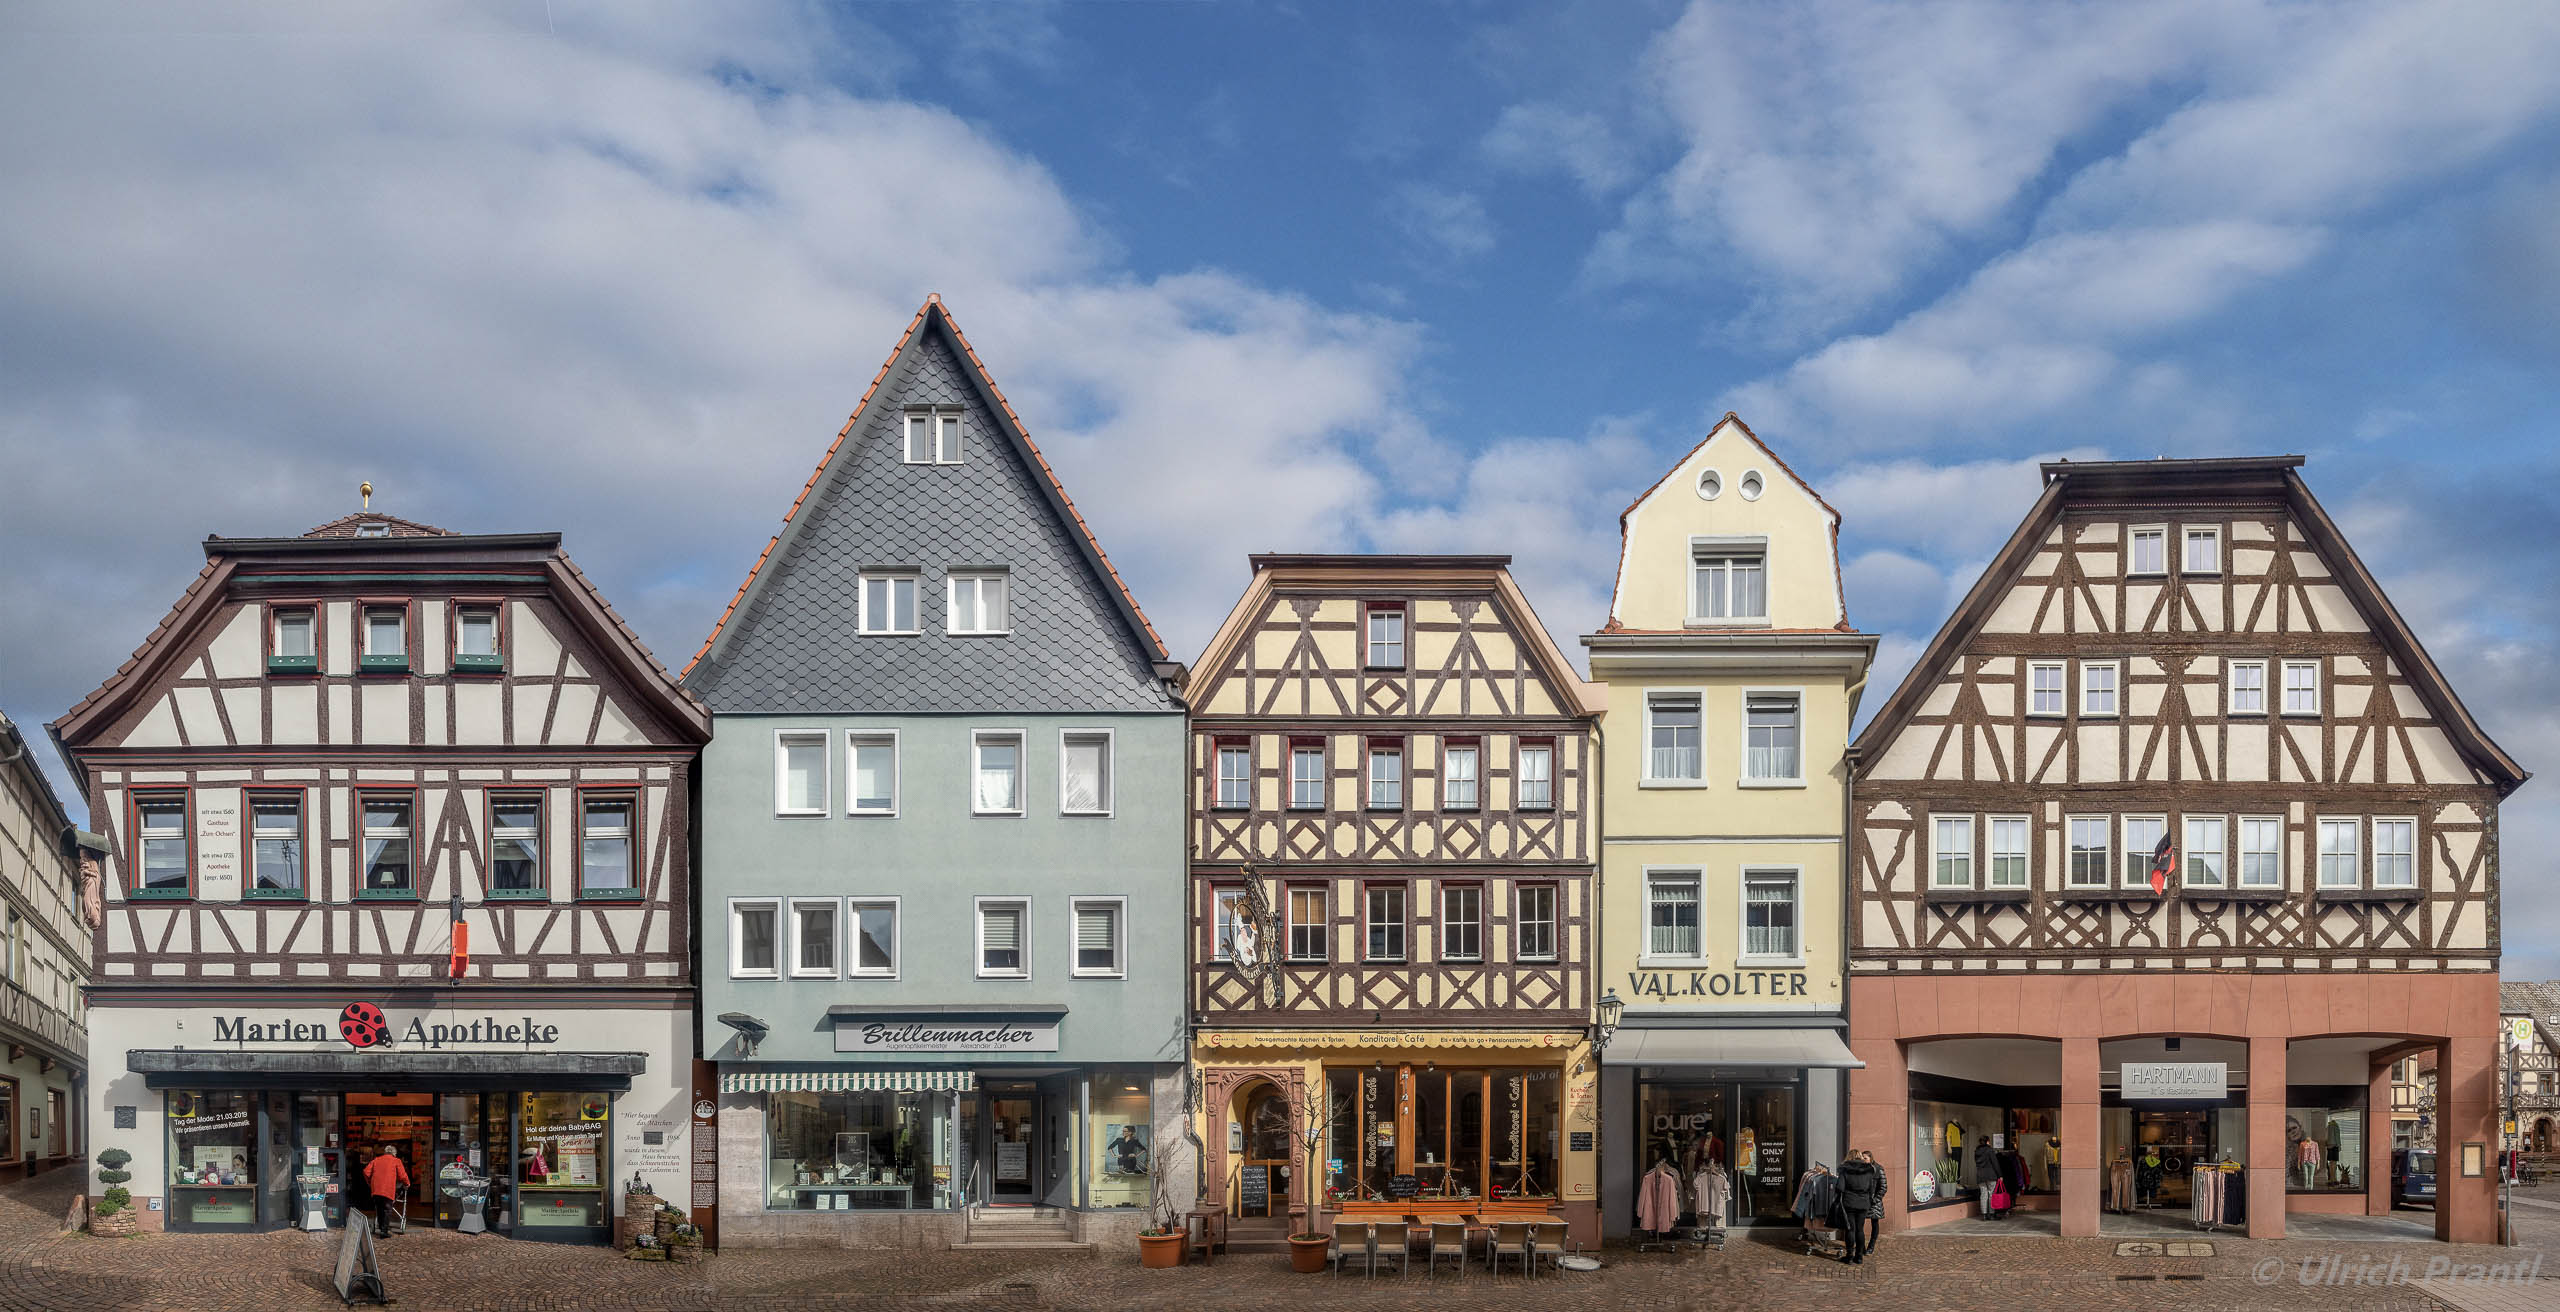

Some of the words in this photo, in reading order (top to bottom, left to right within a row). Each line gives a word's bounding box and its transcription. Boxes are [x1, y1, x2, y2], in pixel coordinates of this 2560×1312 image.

[213, 1016, 328, 1042] Marien
[403, 1016, 559, 1048] Apotheke
[862, 1023, 1034, 1044] Brillenmacher
[2132, 1067, 2218, 1084] HARTMANN
[1366, 1077, 1376, 1102] Café
[568, 1122, 601, 1131] BabyBAG
[1654, 1113, 1705, 1133] pure
[1366, 1110, 1376, 1167] Konditorei
